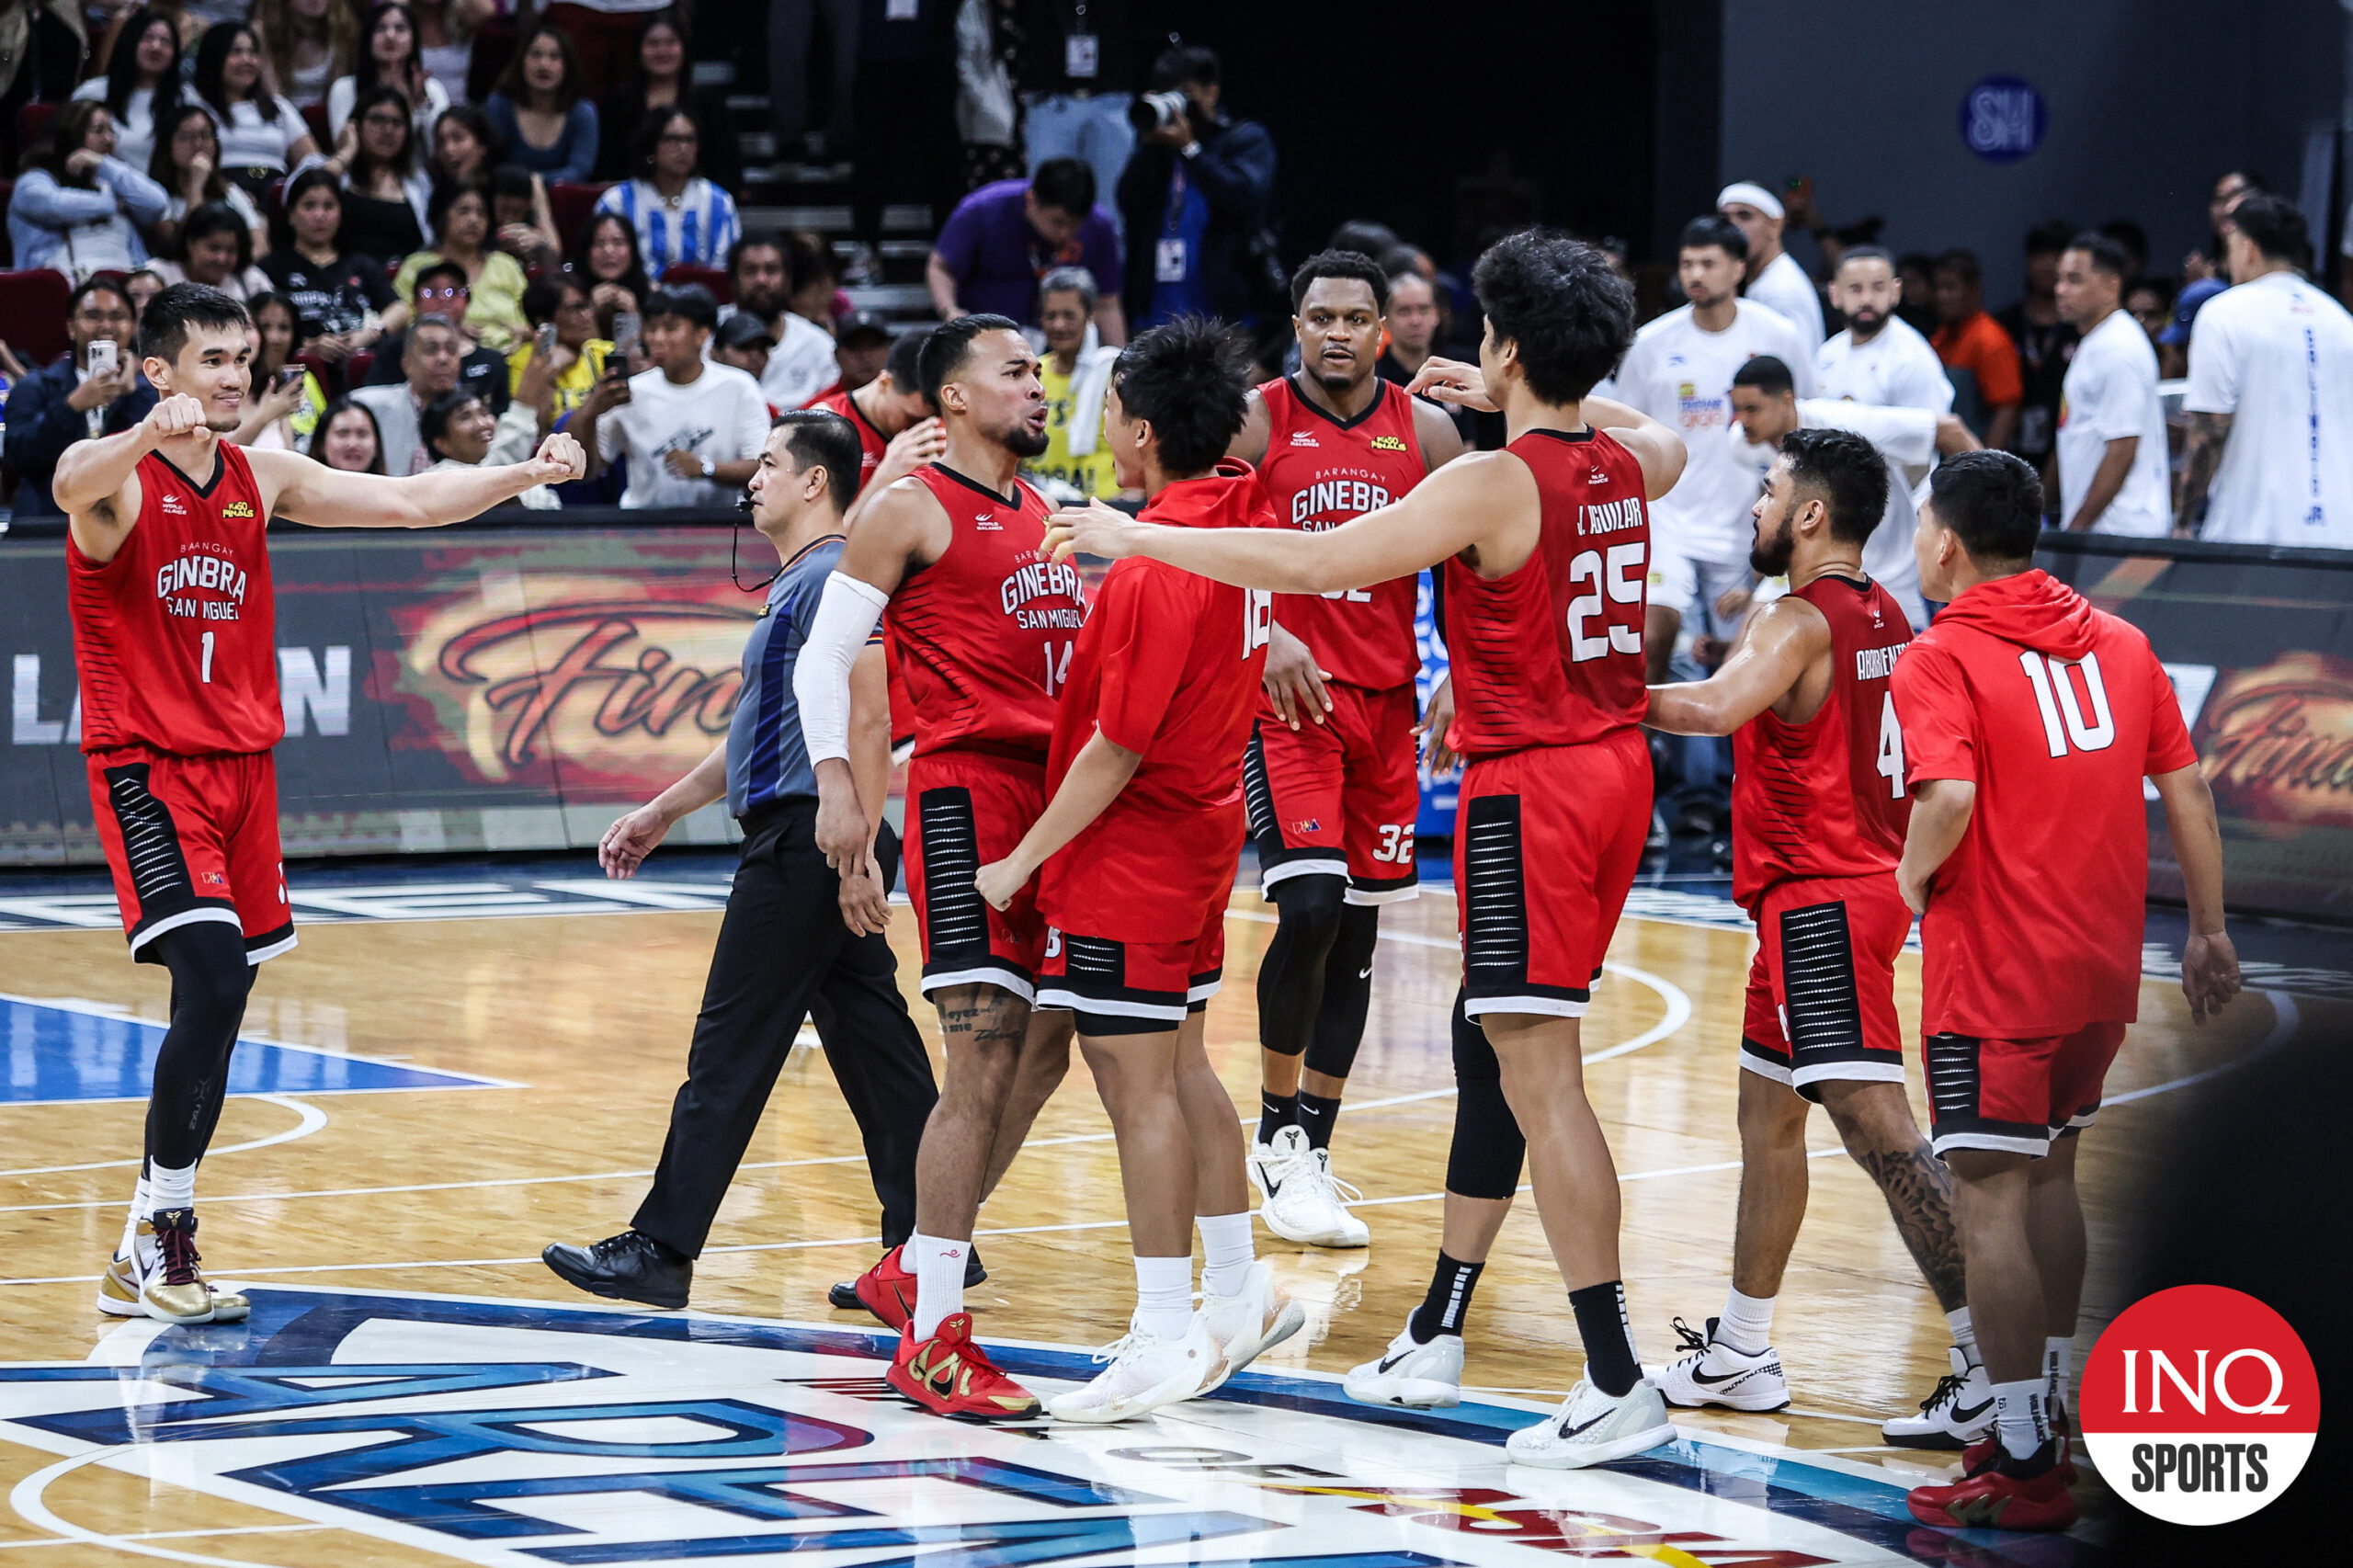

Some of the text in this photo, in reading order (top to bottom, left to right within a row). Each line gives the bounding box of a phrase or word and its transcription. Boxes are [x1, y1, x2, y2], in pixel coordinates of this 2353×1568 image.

[1315, 467, 1386, 483] BARANGAY
[1290, 480, 1403, 525] GINEBR
[1000, 561, 1087, 616] GINEBRA
[1566, 540, 1646, 663] 25
[1016, 608, 1048, 630] SAN
[200, 631, 215, 684] 1
[2018, 648, 2117, 759] 10
[1875, 689, 1906, 800] 4
[1371, 824, 1415, 864] 32
